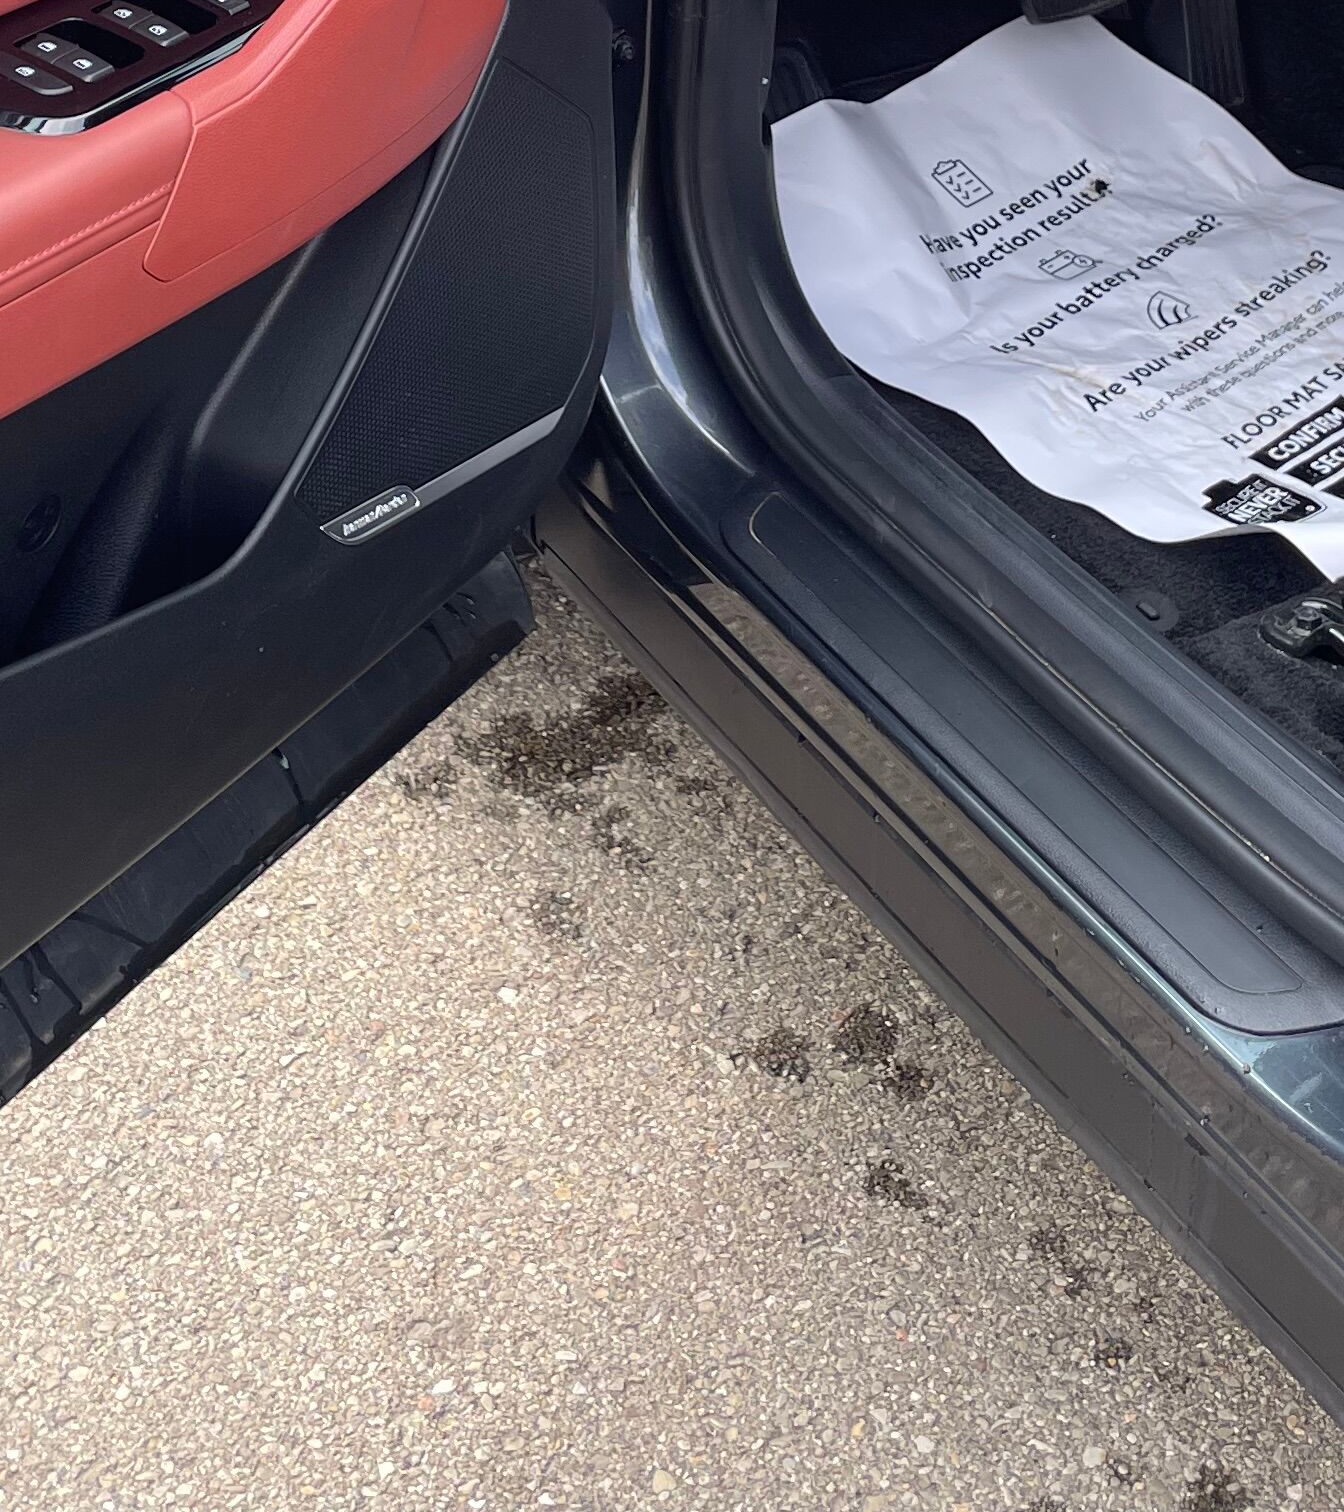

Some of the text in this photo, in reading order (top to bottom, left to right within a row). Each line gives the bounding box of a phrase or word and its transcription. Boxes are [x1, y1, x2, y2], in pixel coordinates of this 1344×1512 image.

[919, 158, 1093, 256] Have you seen your
[990, 213, 1224, 356] Is your battery charged?
[1082, 249, 1333, 414] Are your wipers streaking?
[1133, 399, 1168, 424] Your
[1222, 402, 1292, 451] FLOOR
[1282, 374, 1330, 411] MAT
[1215, 484, 1260, 515] SECURE
[1227, 486, 1289, 523] NEVER
